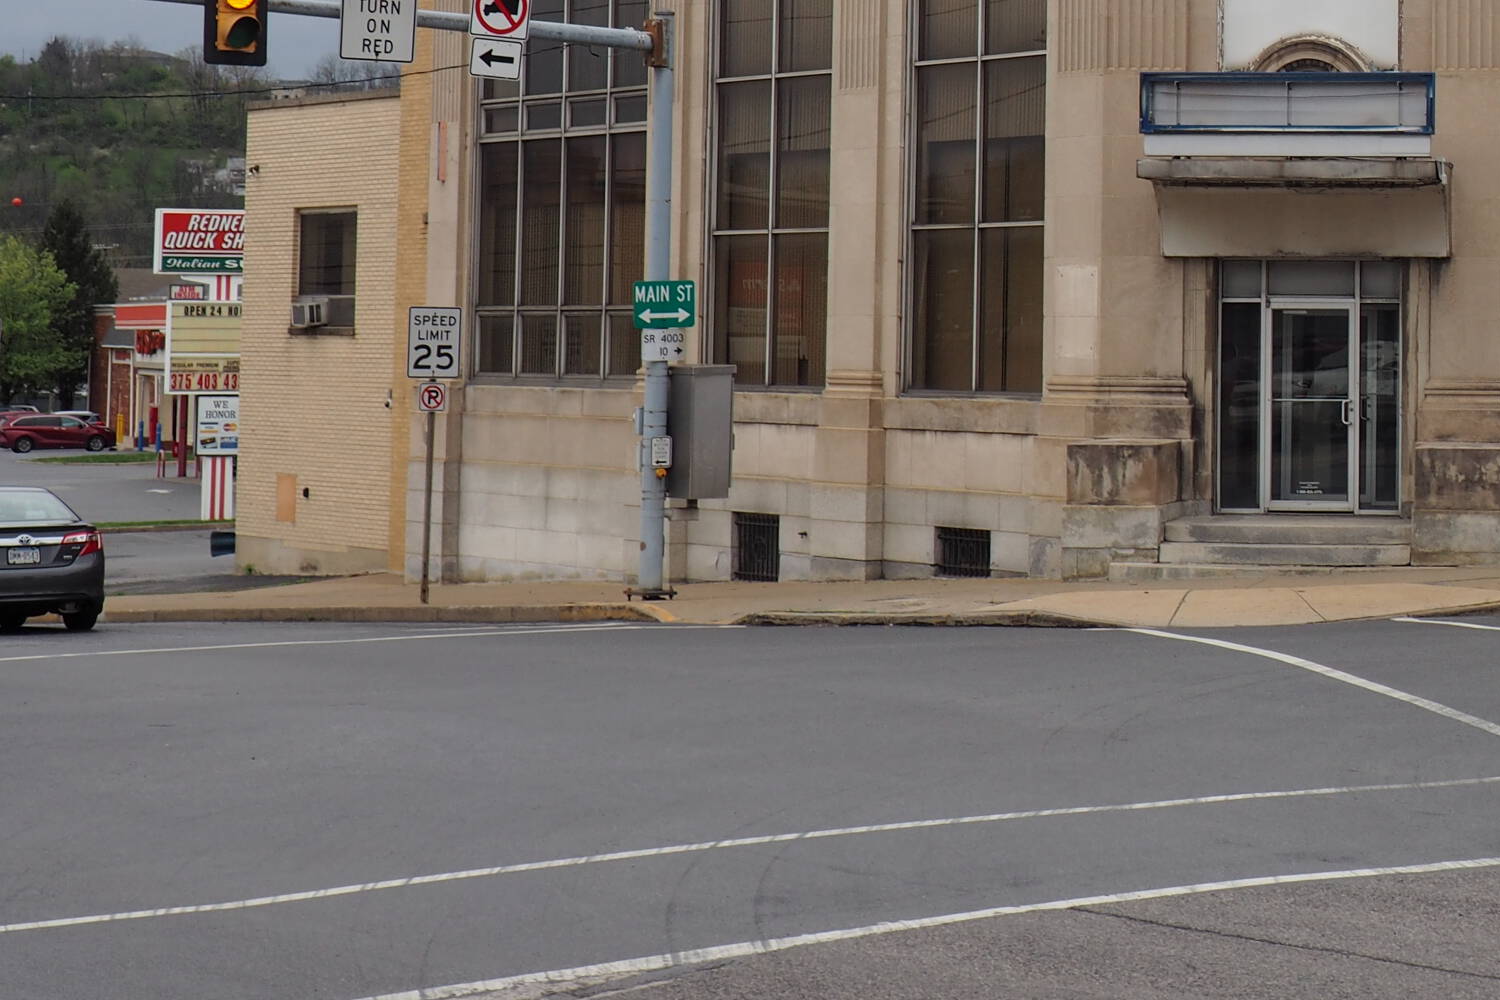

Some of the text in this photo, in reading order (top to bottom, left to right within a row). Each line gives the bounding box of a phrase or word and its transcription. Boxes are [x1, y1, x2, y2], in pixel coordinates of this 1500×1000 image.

[366, 18, 390, 34] ON
[362, 38, 394, 54] RED
[164, 231, 218, 249] QUICK
[166, 258, 220, 268] Italian
[635, 284, 693, 303] MAIN ST
[184, 305, 242, 316] OPEN 24 HO
[414, 314, 457, 327] SPEED
[418, 330, 451, 341] LIMIT
[643, 333, 684, 344] SR 4003
[413, 344, 454, 370] 25
[660, 346, 668, 356] 10
[171, 373, 239, 389] 375 403 43
[213, 400, 229, 409] WE
[205, 410, 236, 419] HONOR
